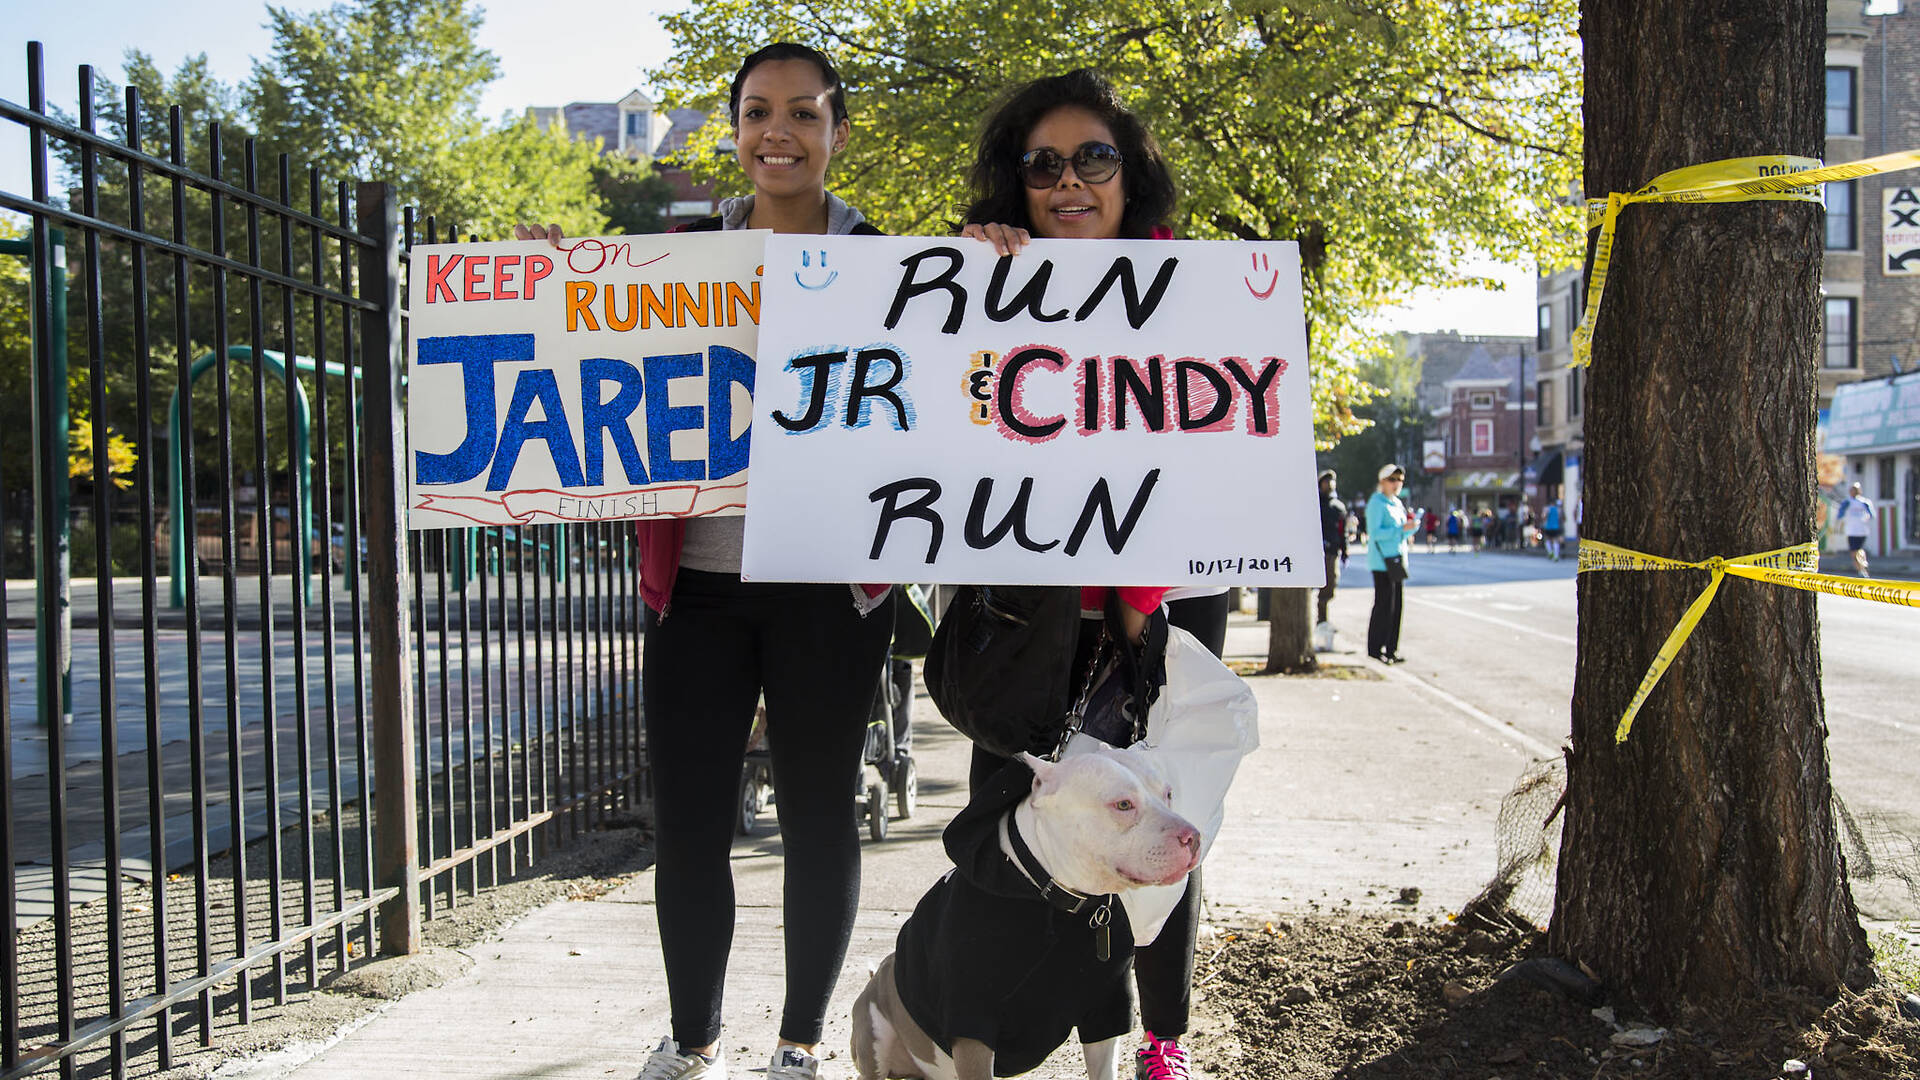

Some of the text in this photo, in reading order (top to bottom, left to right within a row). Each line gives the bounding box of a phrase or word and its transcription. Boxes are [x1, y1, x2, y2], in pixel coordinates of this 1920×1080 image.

[427, 239, 670, 303] KEEP On
[884, 247, 1179, 334] RUN
[415, 333, 756, 492] JARED
[771, 348, 911, 432] JR
[999, 348, 1281, 437] CINDY
[558, 493, 660, 518] FINISH
[868, 468, 1161, 564] RUN
[1188, 556, 1293, 576] 10/12/2014
